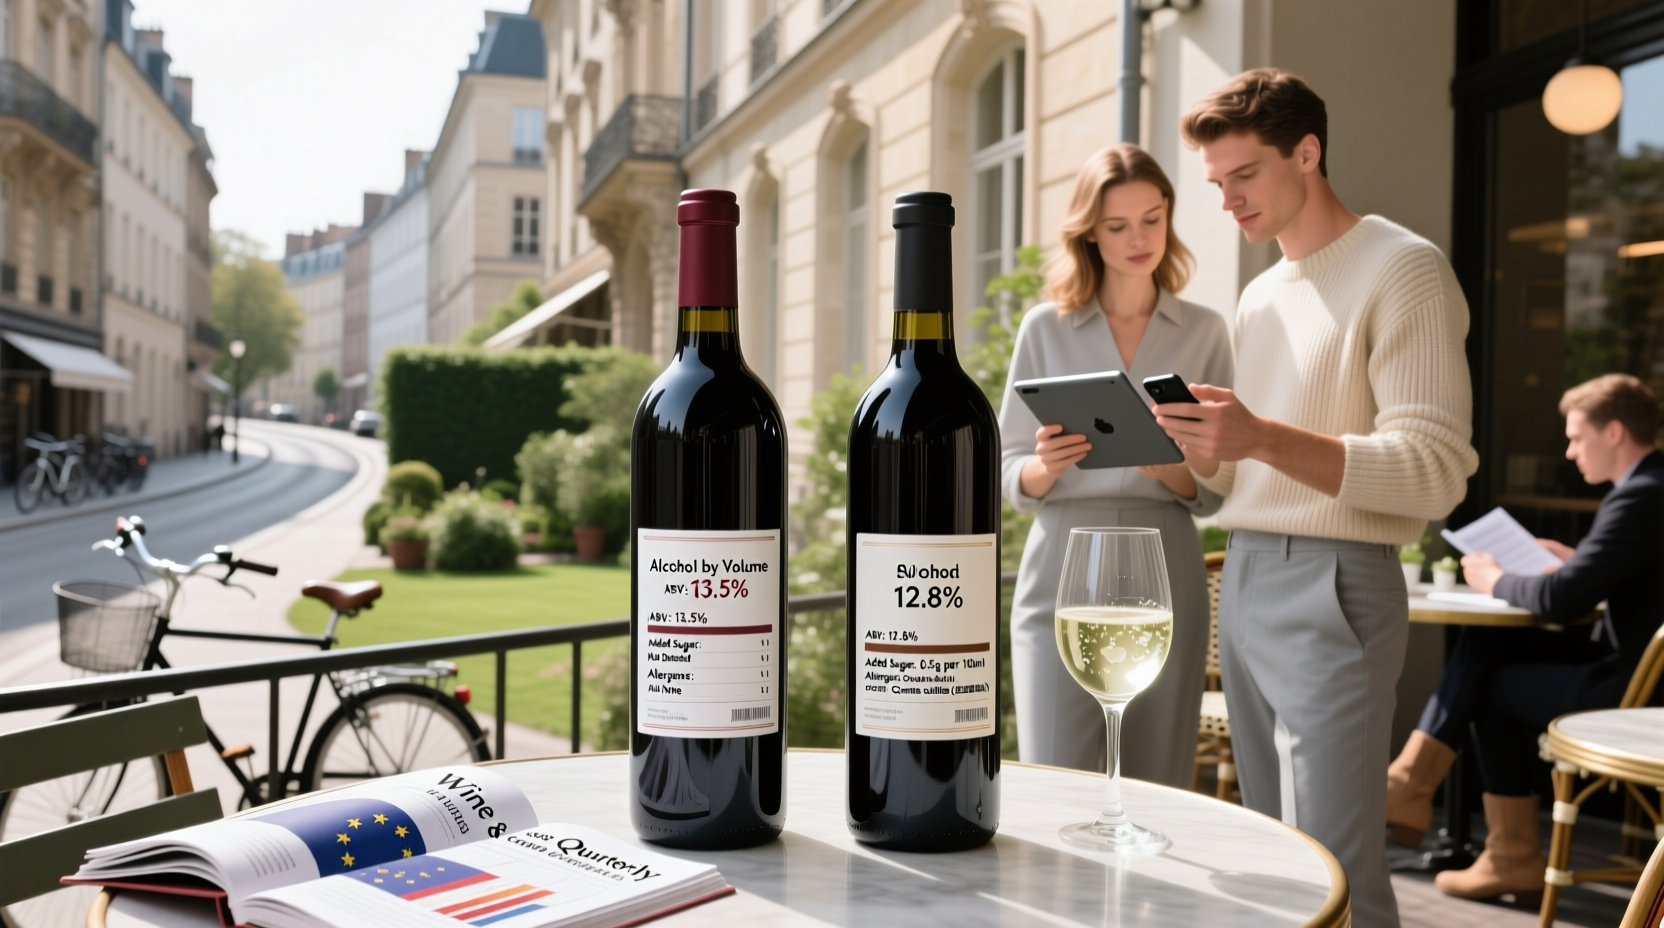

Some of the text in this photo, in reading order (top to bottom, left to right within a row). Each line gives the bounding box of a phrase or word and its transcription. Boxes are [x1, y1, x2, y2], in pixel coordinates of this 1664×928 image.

[650, 558, 768, 576] Alcohol by Volume
[691, 579, 748, 598] 13.5%
[894, 586, 963, 608] 12.8%
[437, 773, 494, 820] Wine
[488, 822, 507, 839] &
